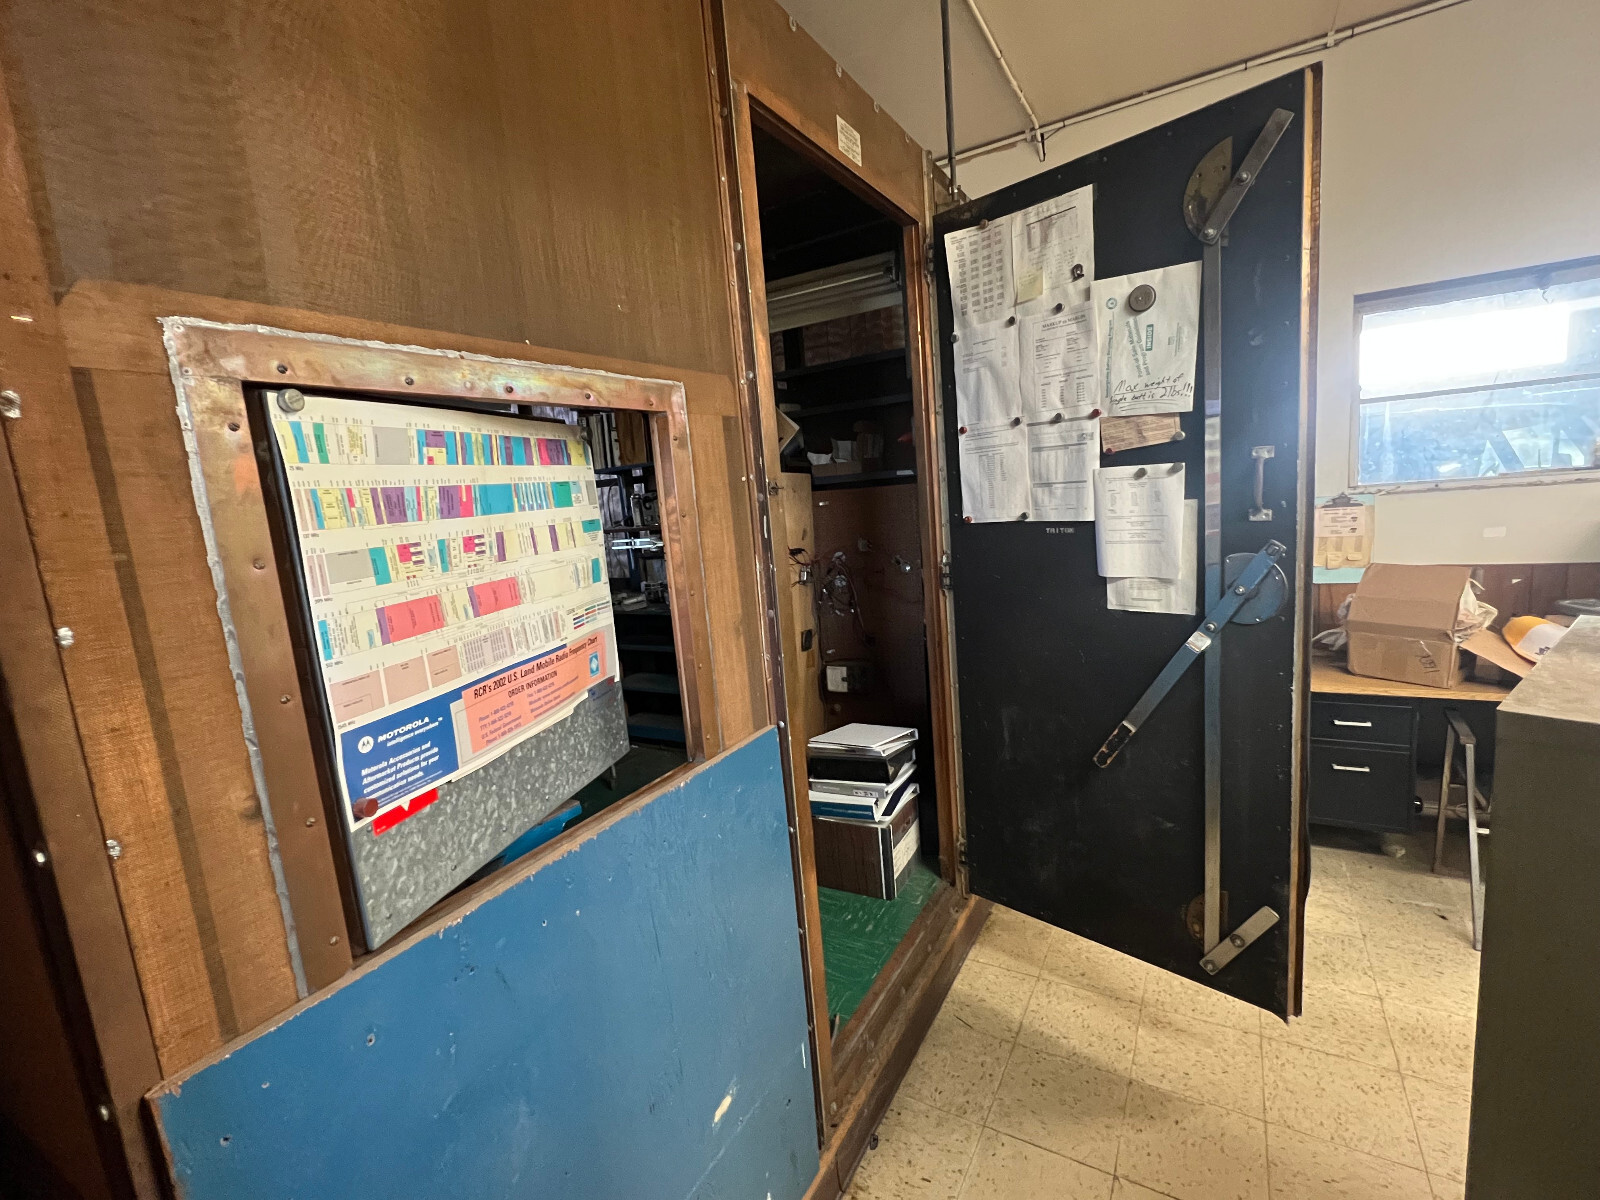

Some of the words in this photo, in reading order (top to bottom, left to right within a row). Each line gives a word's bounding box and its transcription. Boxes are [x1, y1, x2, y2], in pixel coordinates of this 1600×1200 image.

[1113, 379, 1138, 394] Max
[1144, 375, 1171, 389] weight
[1172, 372, 1184, 383] of
[473, 685, 492, 699] RCR's
[493, 677, 506, 690] 2002
[507, 671, 519, 684] U.S.
[520, 665, 535, 678] Land
[536, 657, 554, 671] Mobile
[555, 651, 568, 663] Radio
[569, 642, 587, 656] Frequency
[587, 636, 598, 646] Chart
[508, 685, 525, 698] ORDER
[526, 670, 557, 690] INFORMATION
[377, 716, 430, 743] MOTOROLA
[361, 760, 388, 776] Motorola
[388, 746, 421, 765] Accessories
[421, 740, 431, 750] and
[362, 765, 396, 785] Aftermarket
[396, 755, 420, 770] Products
[420, 760, 428, 768] for
